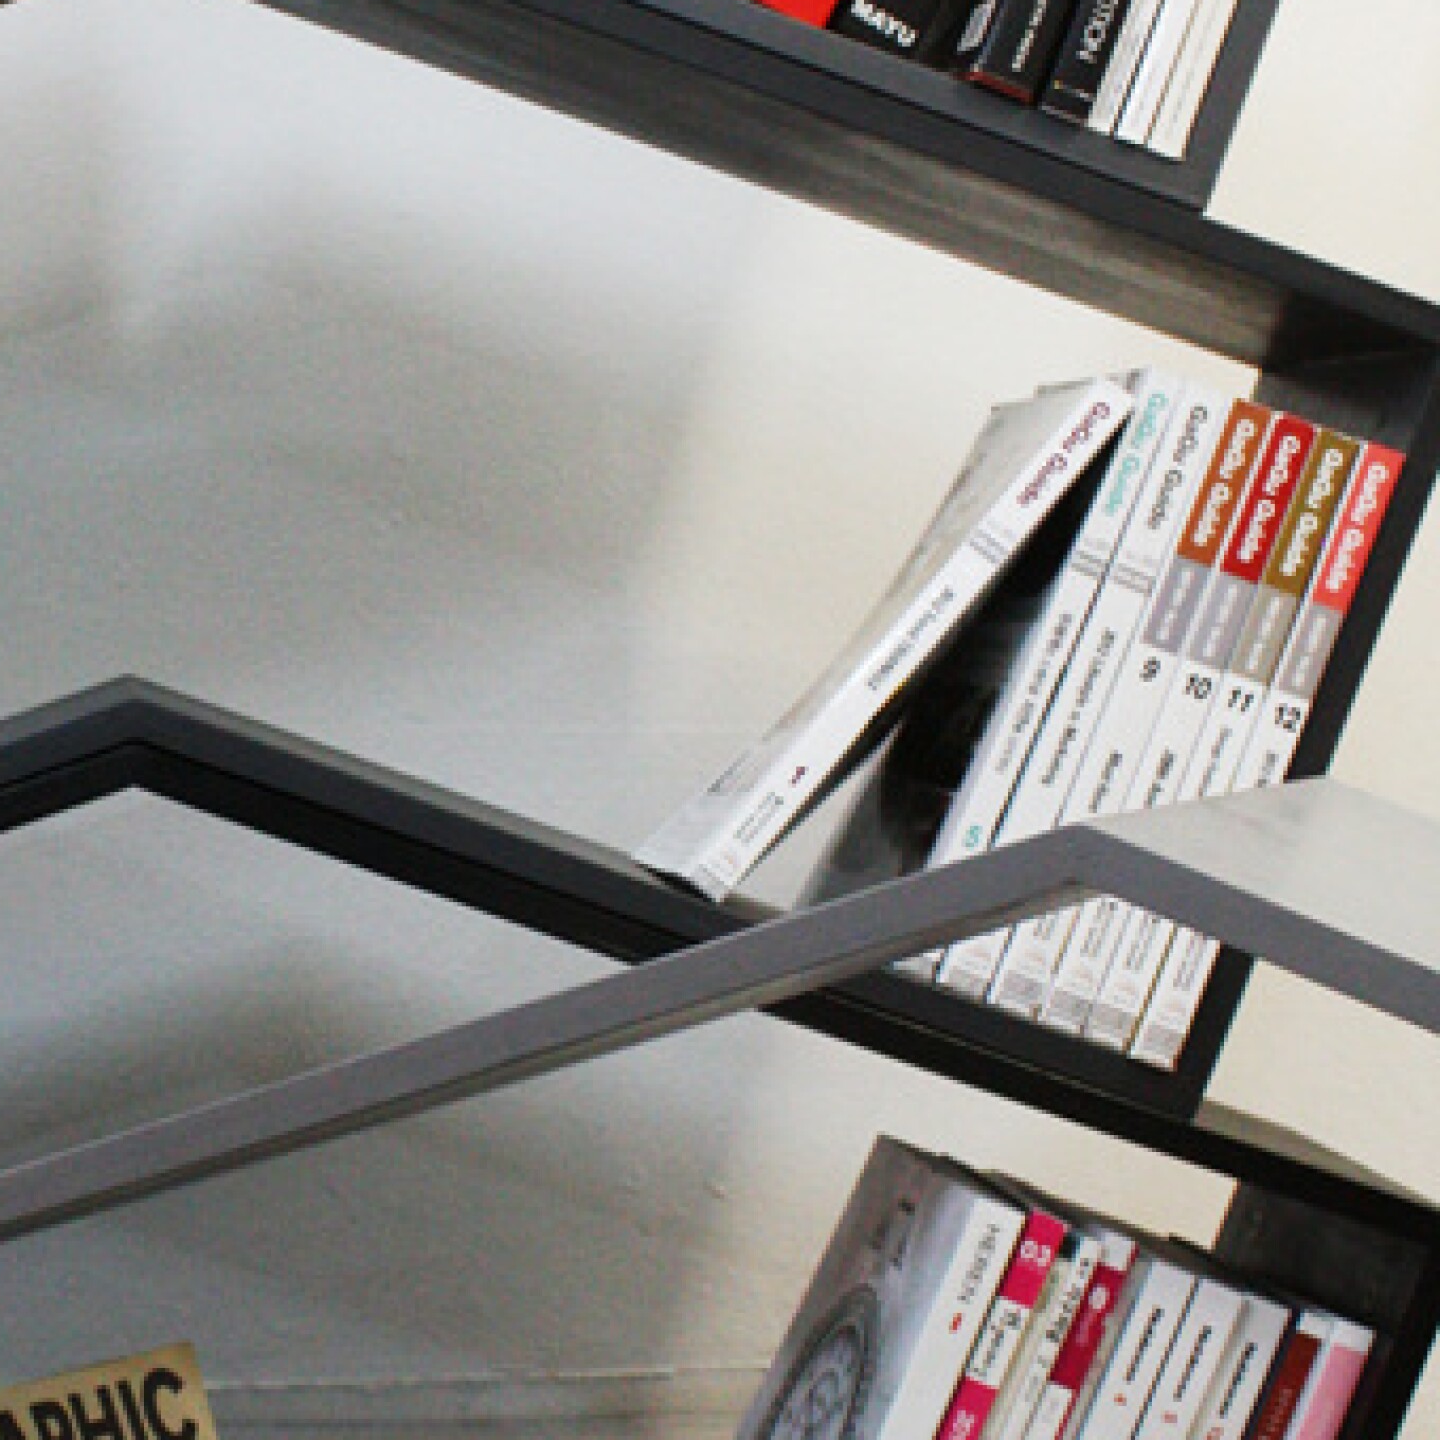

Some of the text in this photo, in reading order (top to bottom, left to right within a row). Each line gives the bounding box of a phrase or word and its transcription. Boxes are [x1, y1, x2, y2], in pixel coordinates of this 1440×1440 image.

[1147, 405, 1208, 530] GaGu Guide
[1194, 420, 1256, 547] GaGu Guide
[1238, 435, 1300, 563] GaGu Guide
[1281, 449, 1343, 577] GaGu Guide
[1326, 528, 1364, 593] Guide
[1182, 672, 1212, 700] 10
[1226, 688, 1253, 713] 11
[1271, 704, 1300, 731] 12
